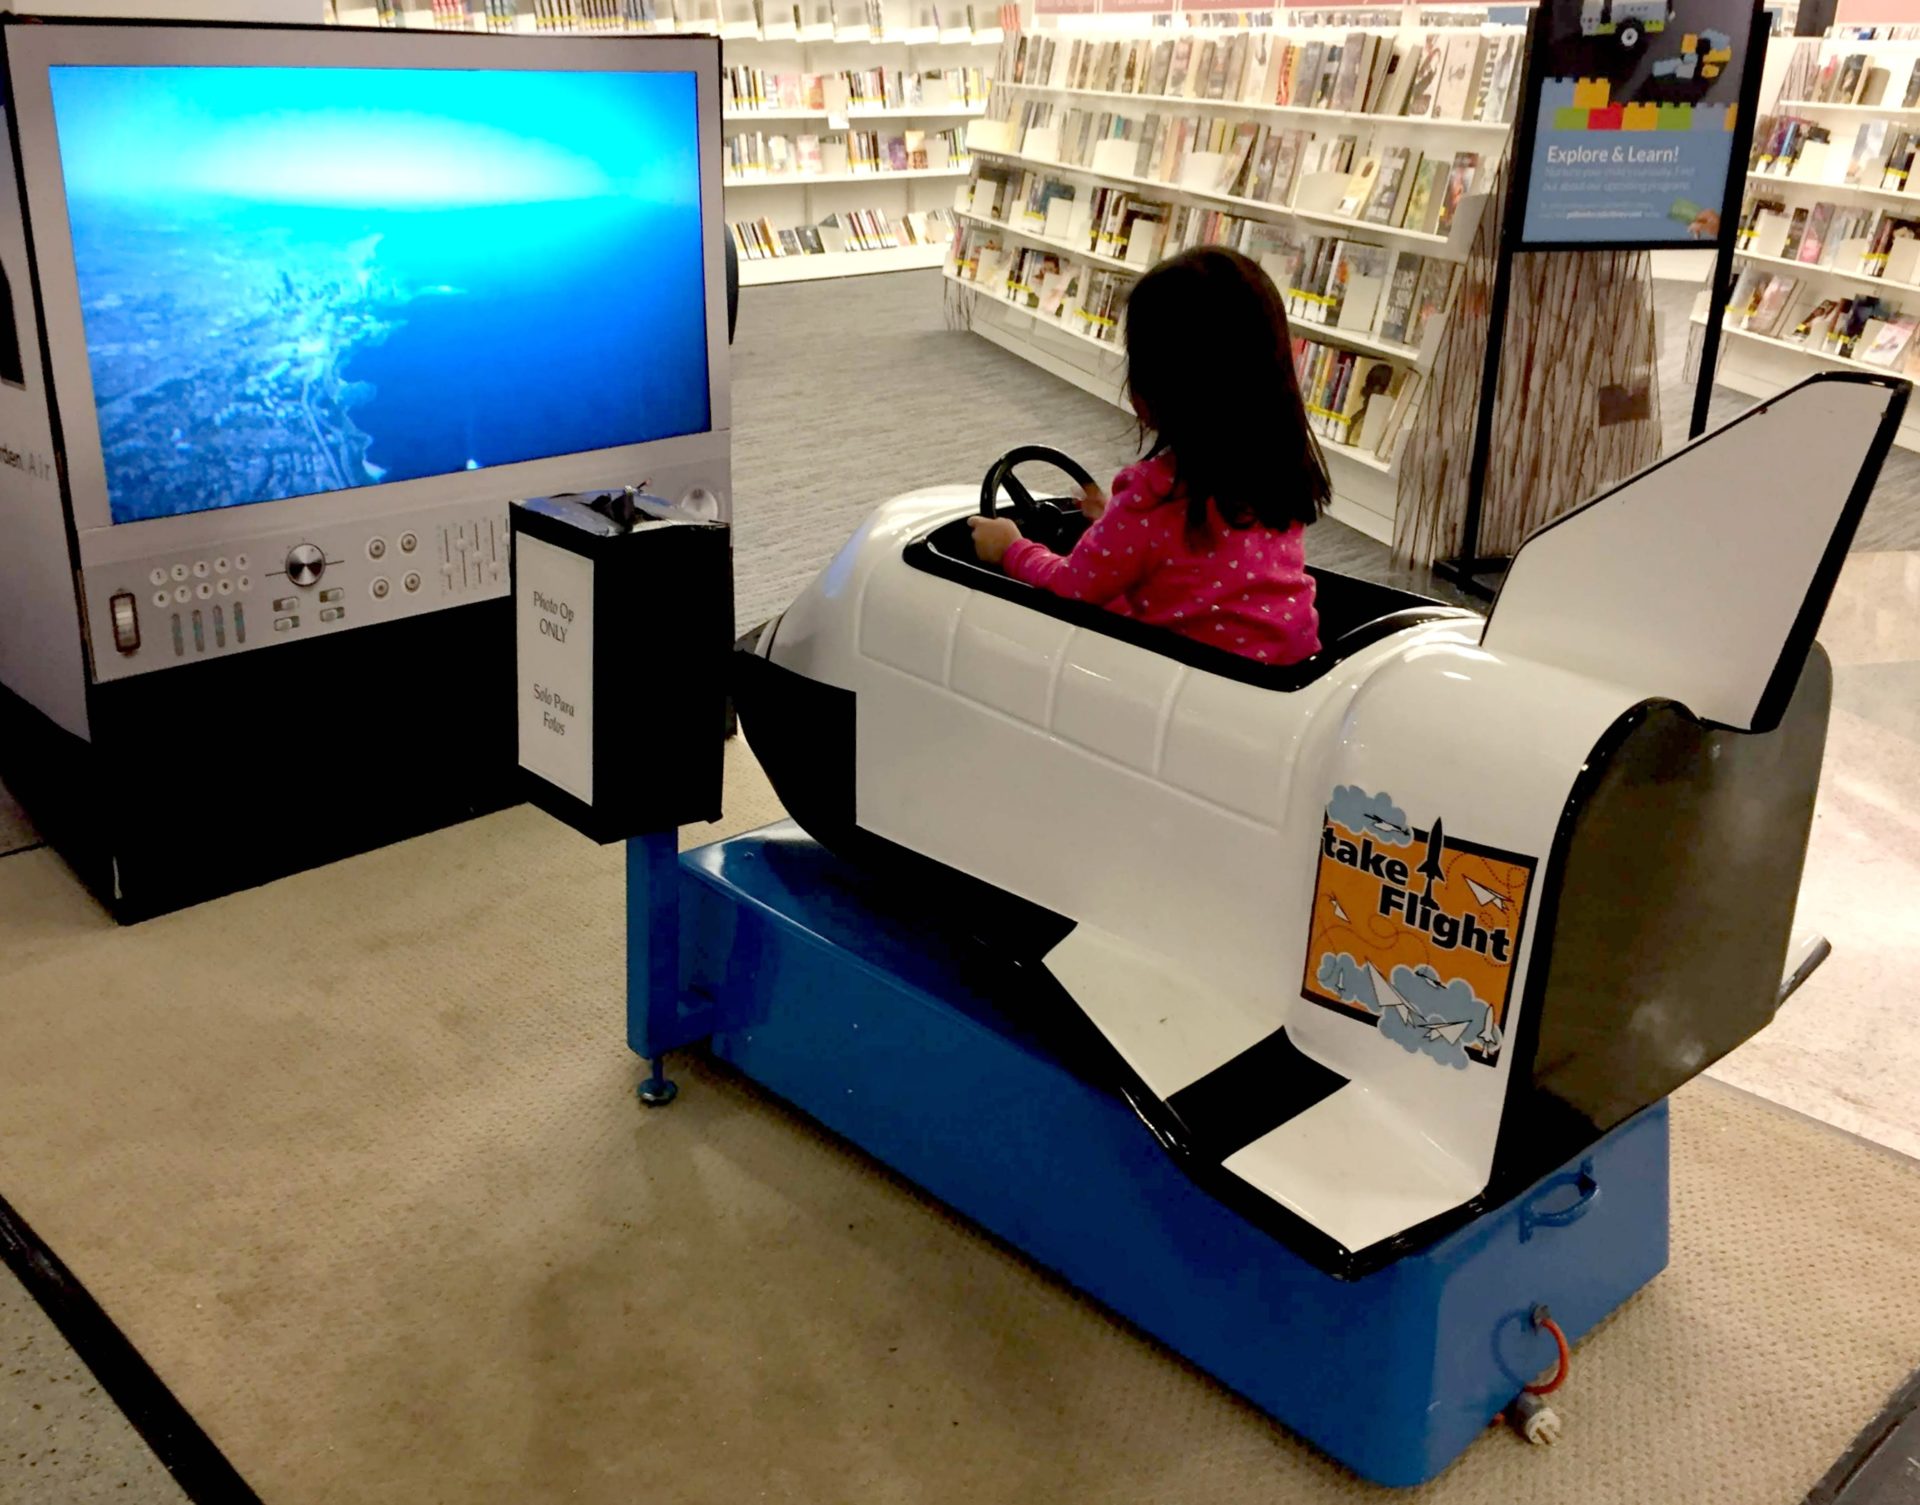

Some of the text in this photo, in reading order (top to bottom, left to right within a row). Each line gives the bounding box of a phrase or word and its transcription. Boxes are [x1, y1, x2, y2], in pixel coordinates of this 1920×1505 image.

[1547, 145, 1680, 166] Explore & Learn!
[533, 591, 575, 623] Photo Op
[539, 617, 567, 644] ONLY
[533, 683, 575, 718] Solo Para
[543, 711, 566, 736] Fotos
[1321, 825, 1410, 886] take
[1377, 883, 1512, 963] Flight
